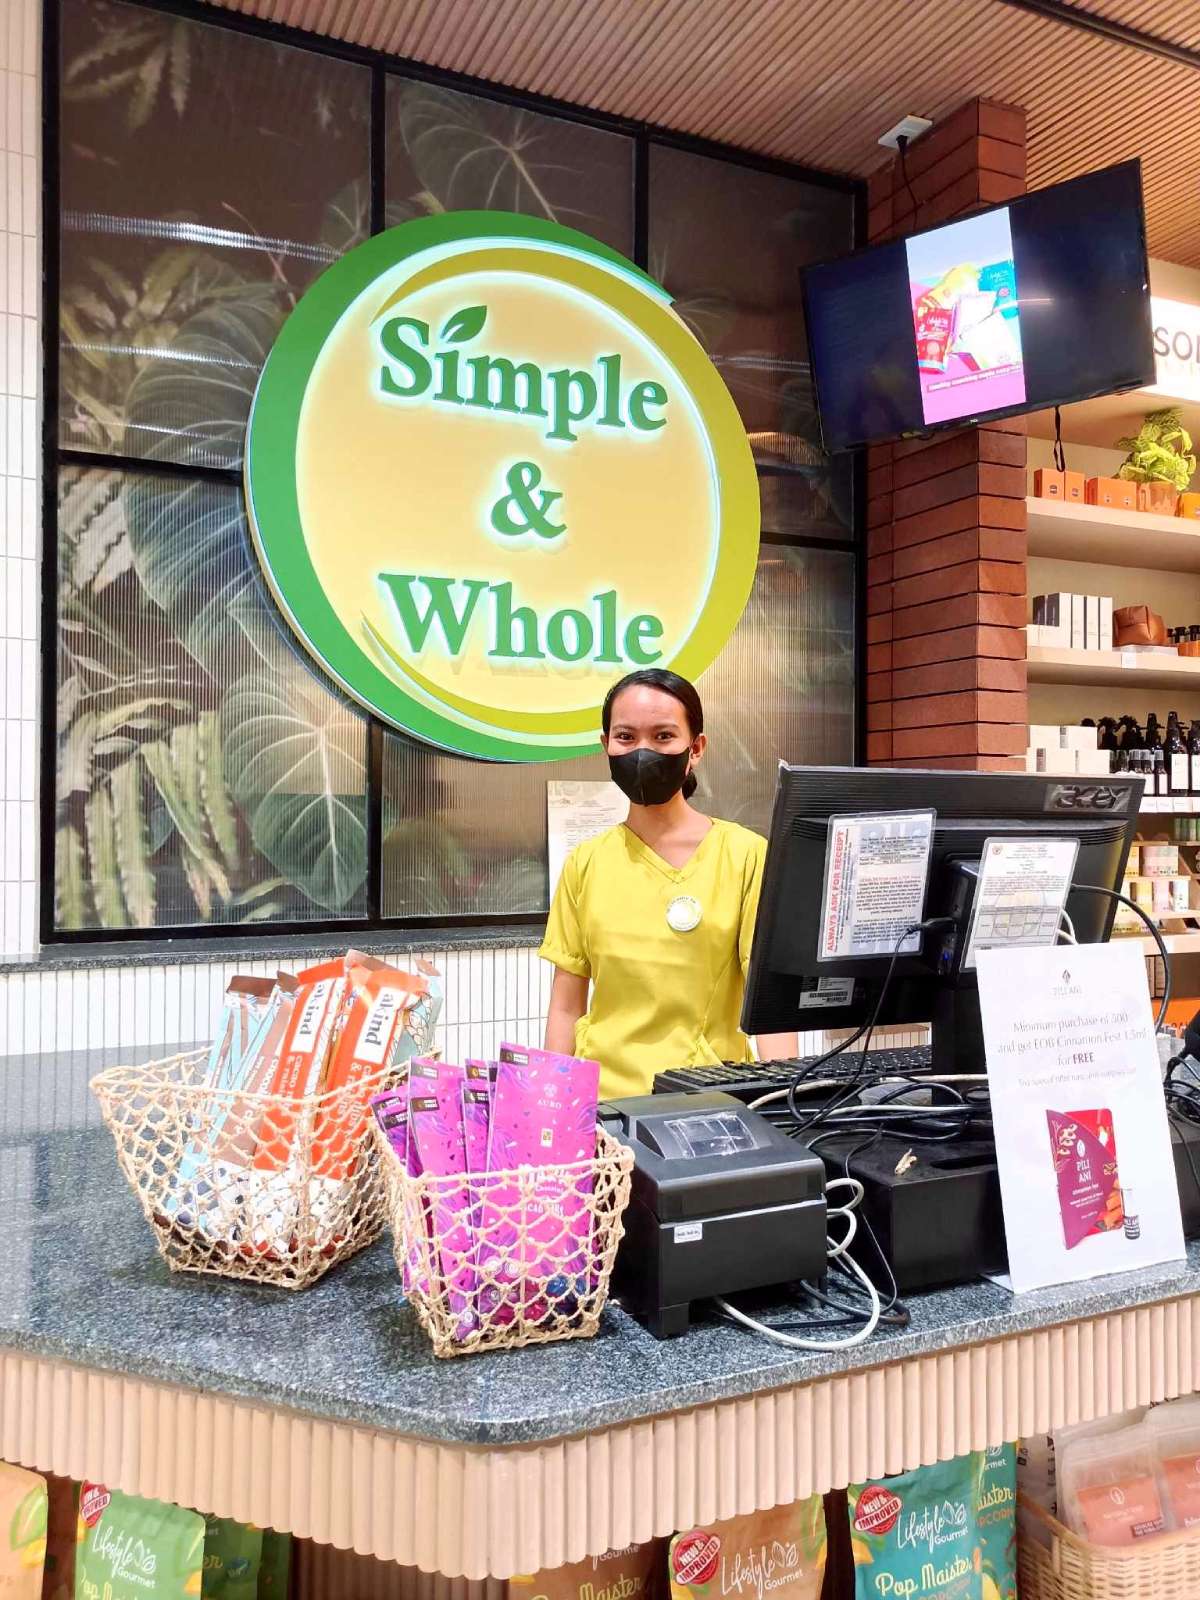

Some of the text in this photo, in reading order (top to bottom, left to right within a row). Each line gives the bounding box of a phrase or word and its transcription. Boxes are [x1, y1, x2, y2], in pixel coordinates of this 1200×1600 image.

[379, 306, 669, 442] Simple
[490, 461, 567, 539] &
[377, 573, 665, 664] Whole
[1072, 1052, 1095, 1065] FREE
[858, 1501, 899, 1529] IMPROVED
[896, 1504, 945, 1554] Lifestyle
[934, 1526, 969, 1545] Gourmet
[679, 1540, 719, 1583] IMPROVED
[721, 1545, 776, 1600] Lifestyle
[764, 1568, 803, 1590] Gourmet
[875, 1572, 919, 1600] Pop
[921, 1554, 973, 1591] Maister
